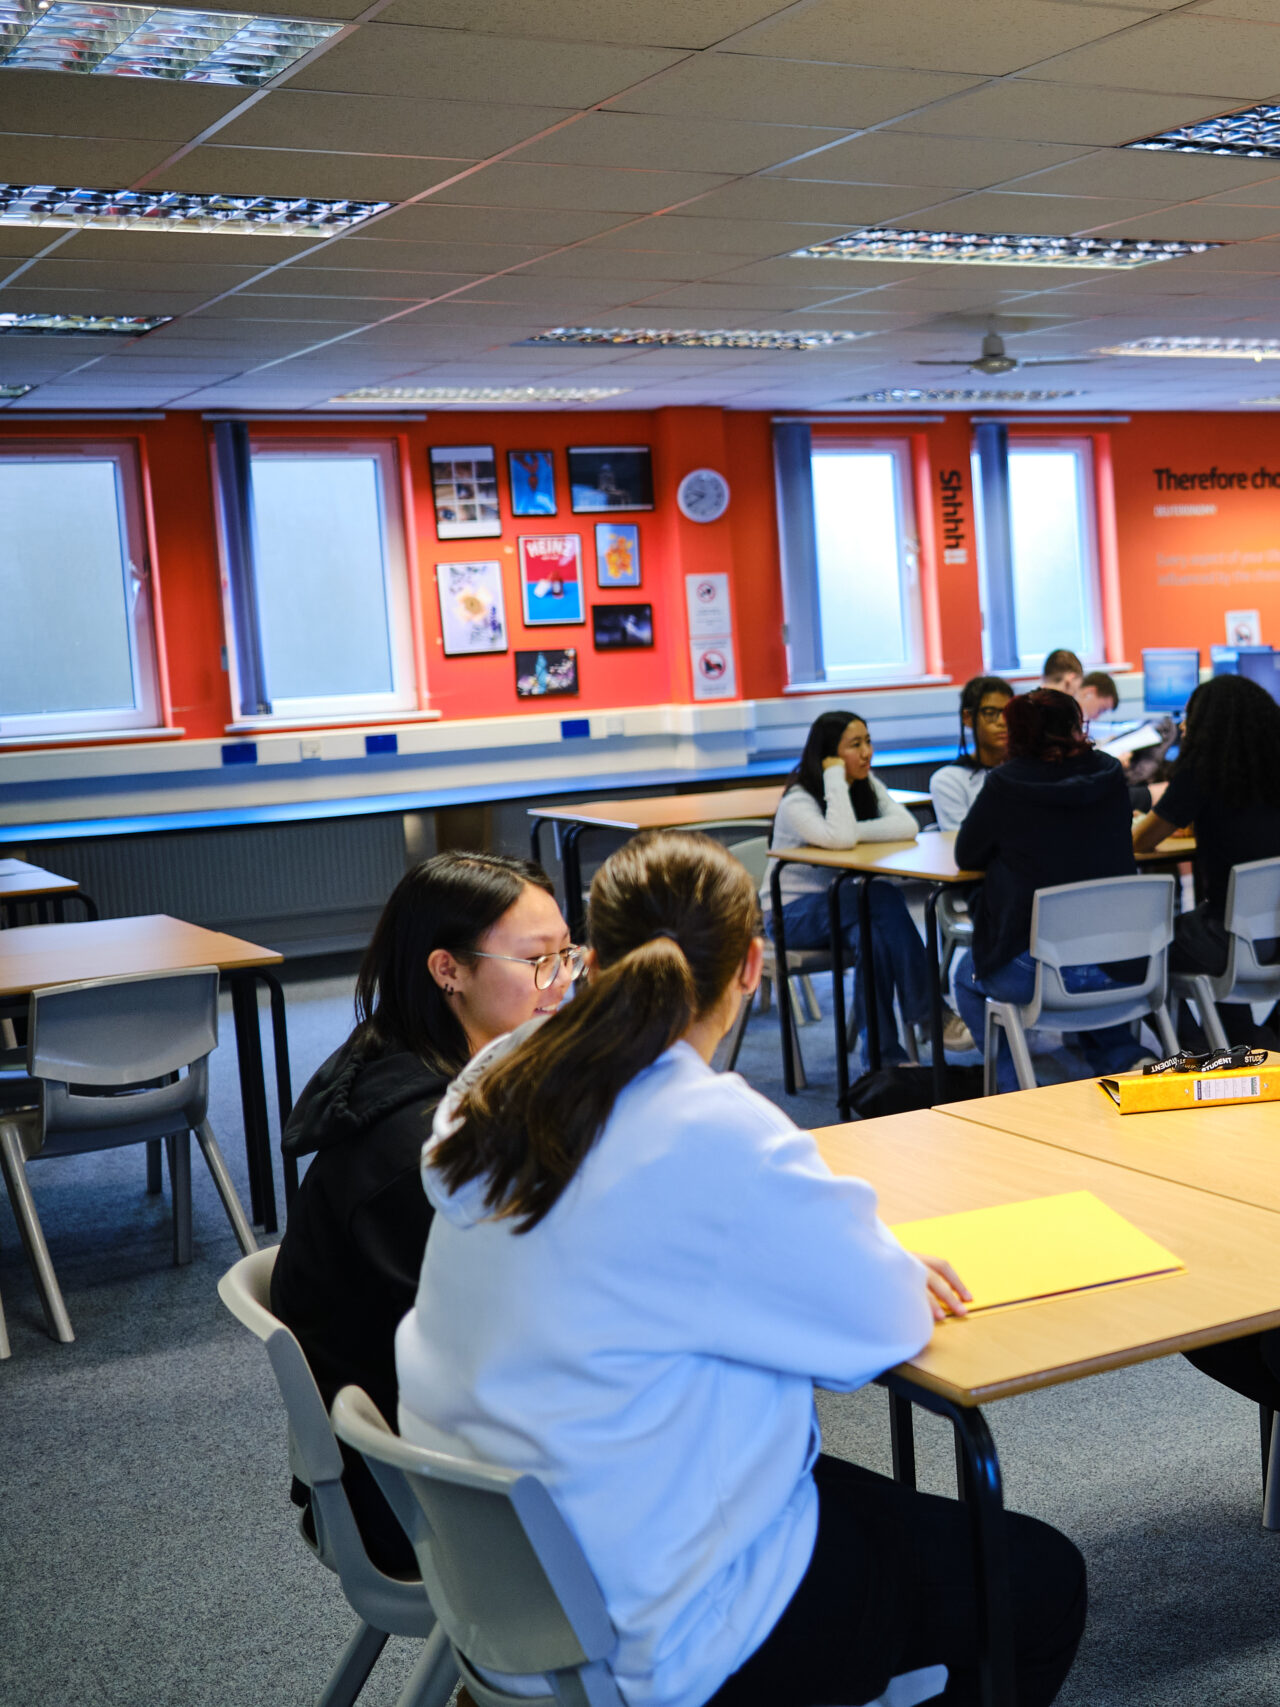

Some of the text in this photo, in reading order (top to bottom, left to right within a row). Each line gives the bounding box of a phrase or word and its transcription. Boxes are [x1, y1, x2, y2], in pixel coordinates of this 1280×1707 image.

[1153, 466, 1248, 491] Therefore
[526, 540, 572, 558] HEINZ
[1201, 1057, 1232, 1072] STUDENT
[1244, 1054, 1264, 1064] STUDE
